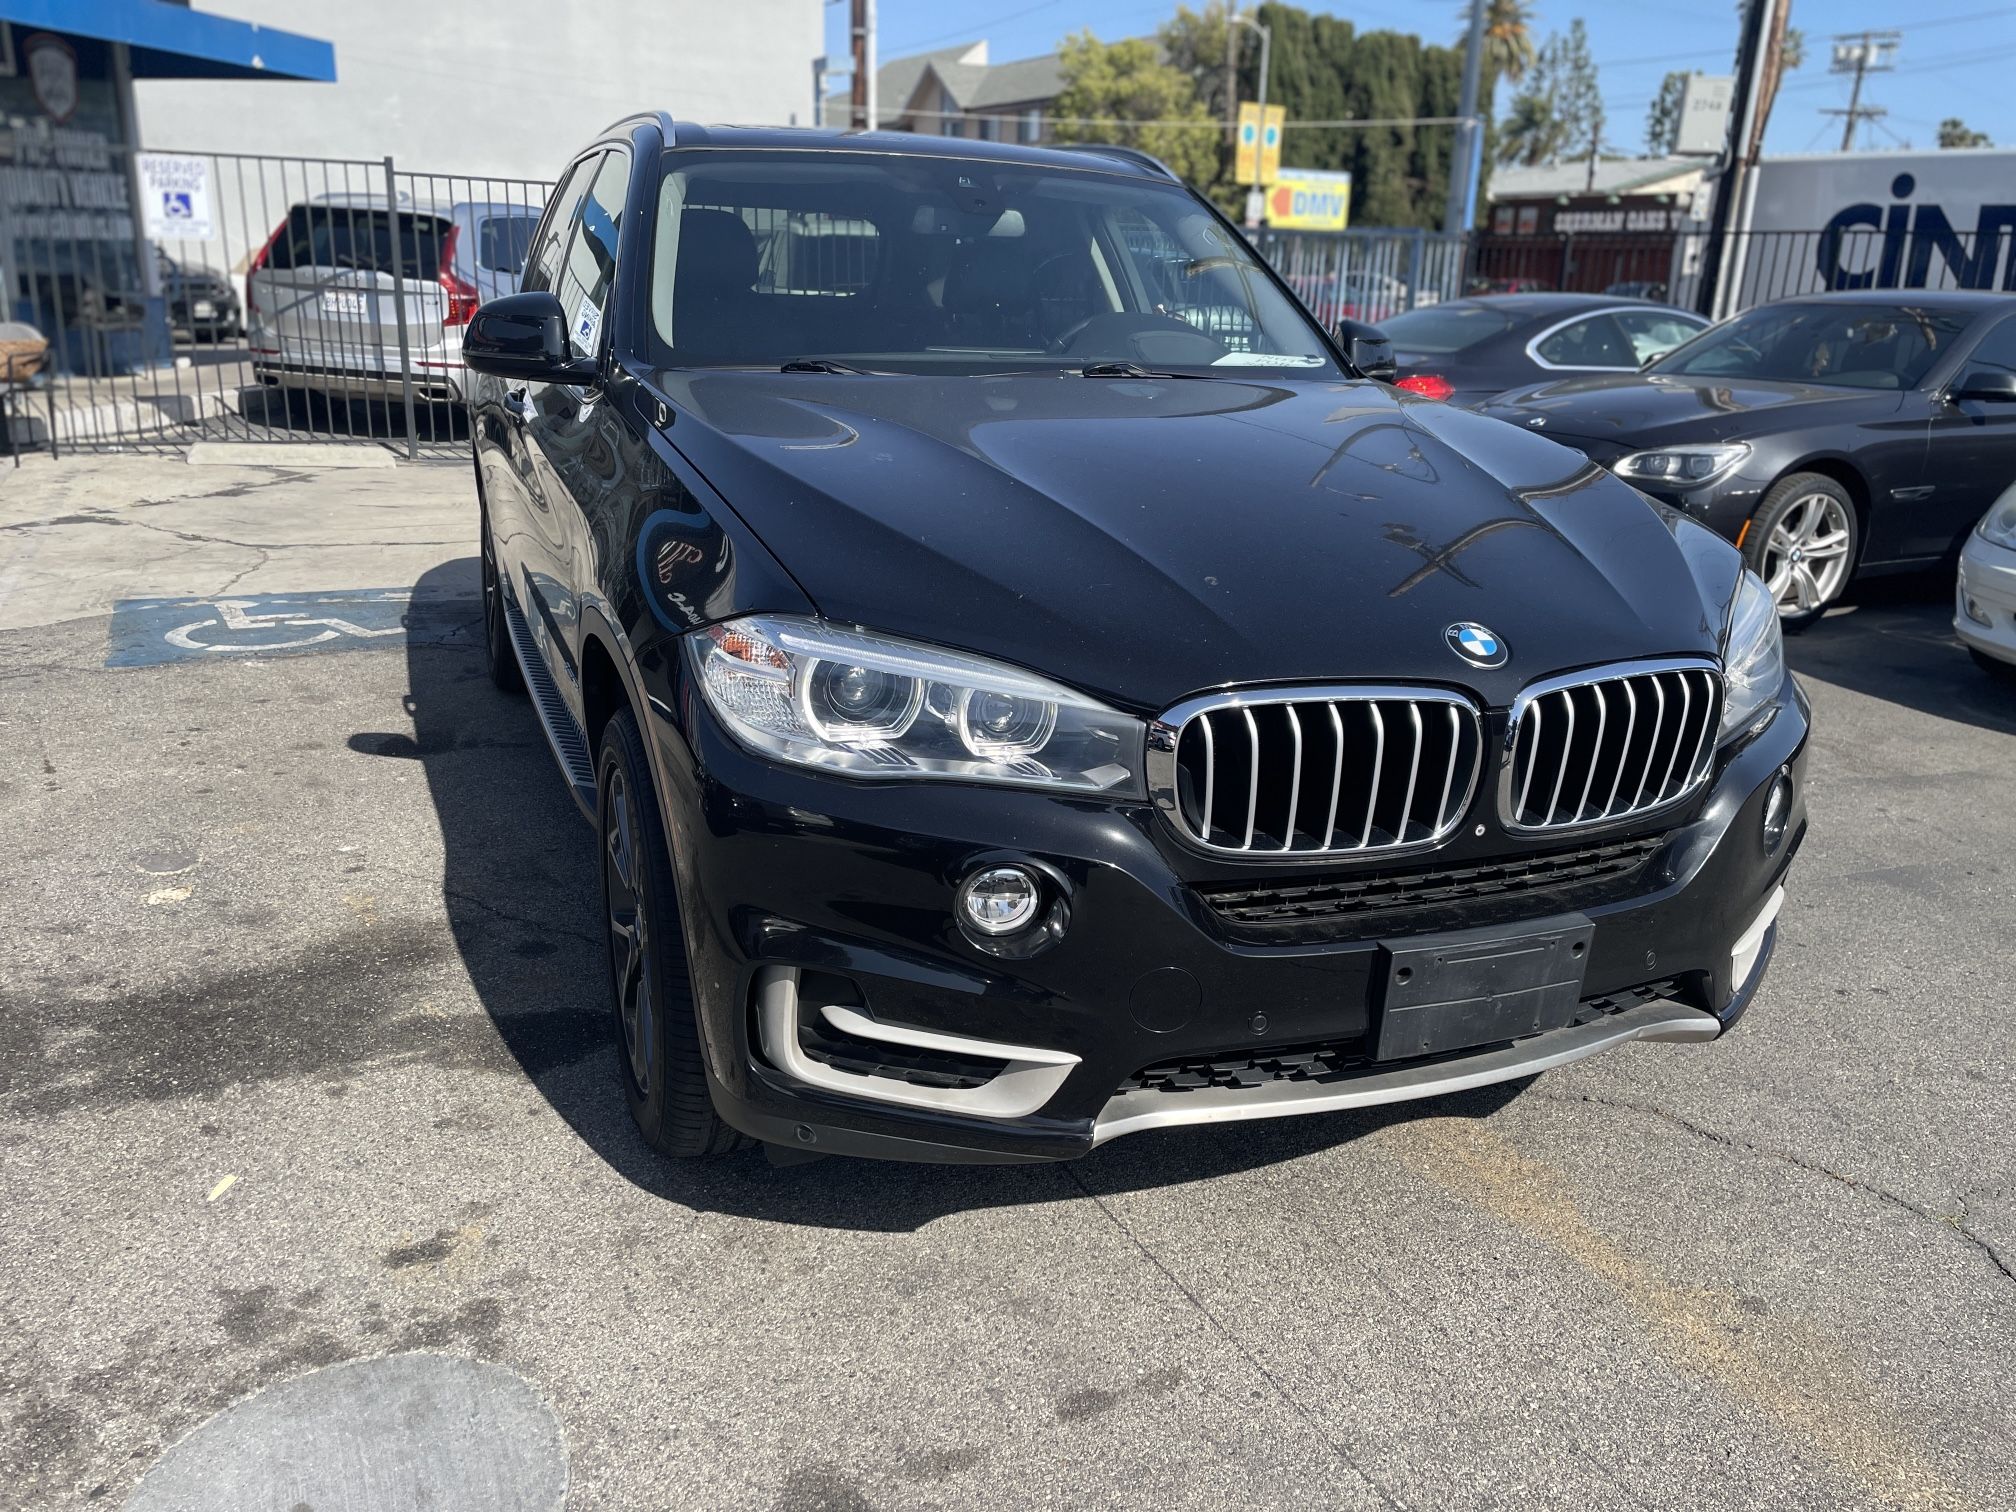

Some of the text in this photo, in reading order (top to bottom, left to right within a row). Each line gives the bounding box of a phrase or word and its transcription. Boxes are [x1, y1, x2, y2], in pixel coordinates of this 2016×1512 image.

[142, 158, 205, 176] RESERVED
[149, 174, 202, 192] PARKING
[1293, 190, 1344, 218] DMV
